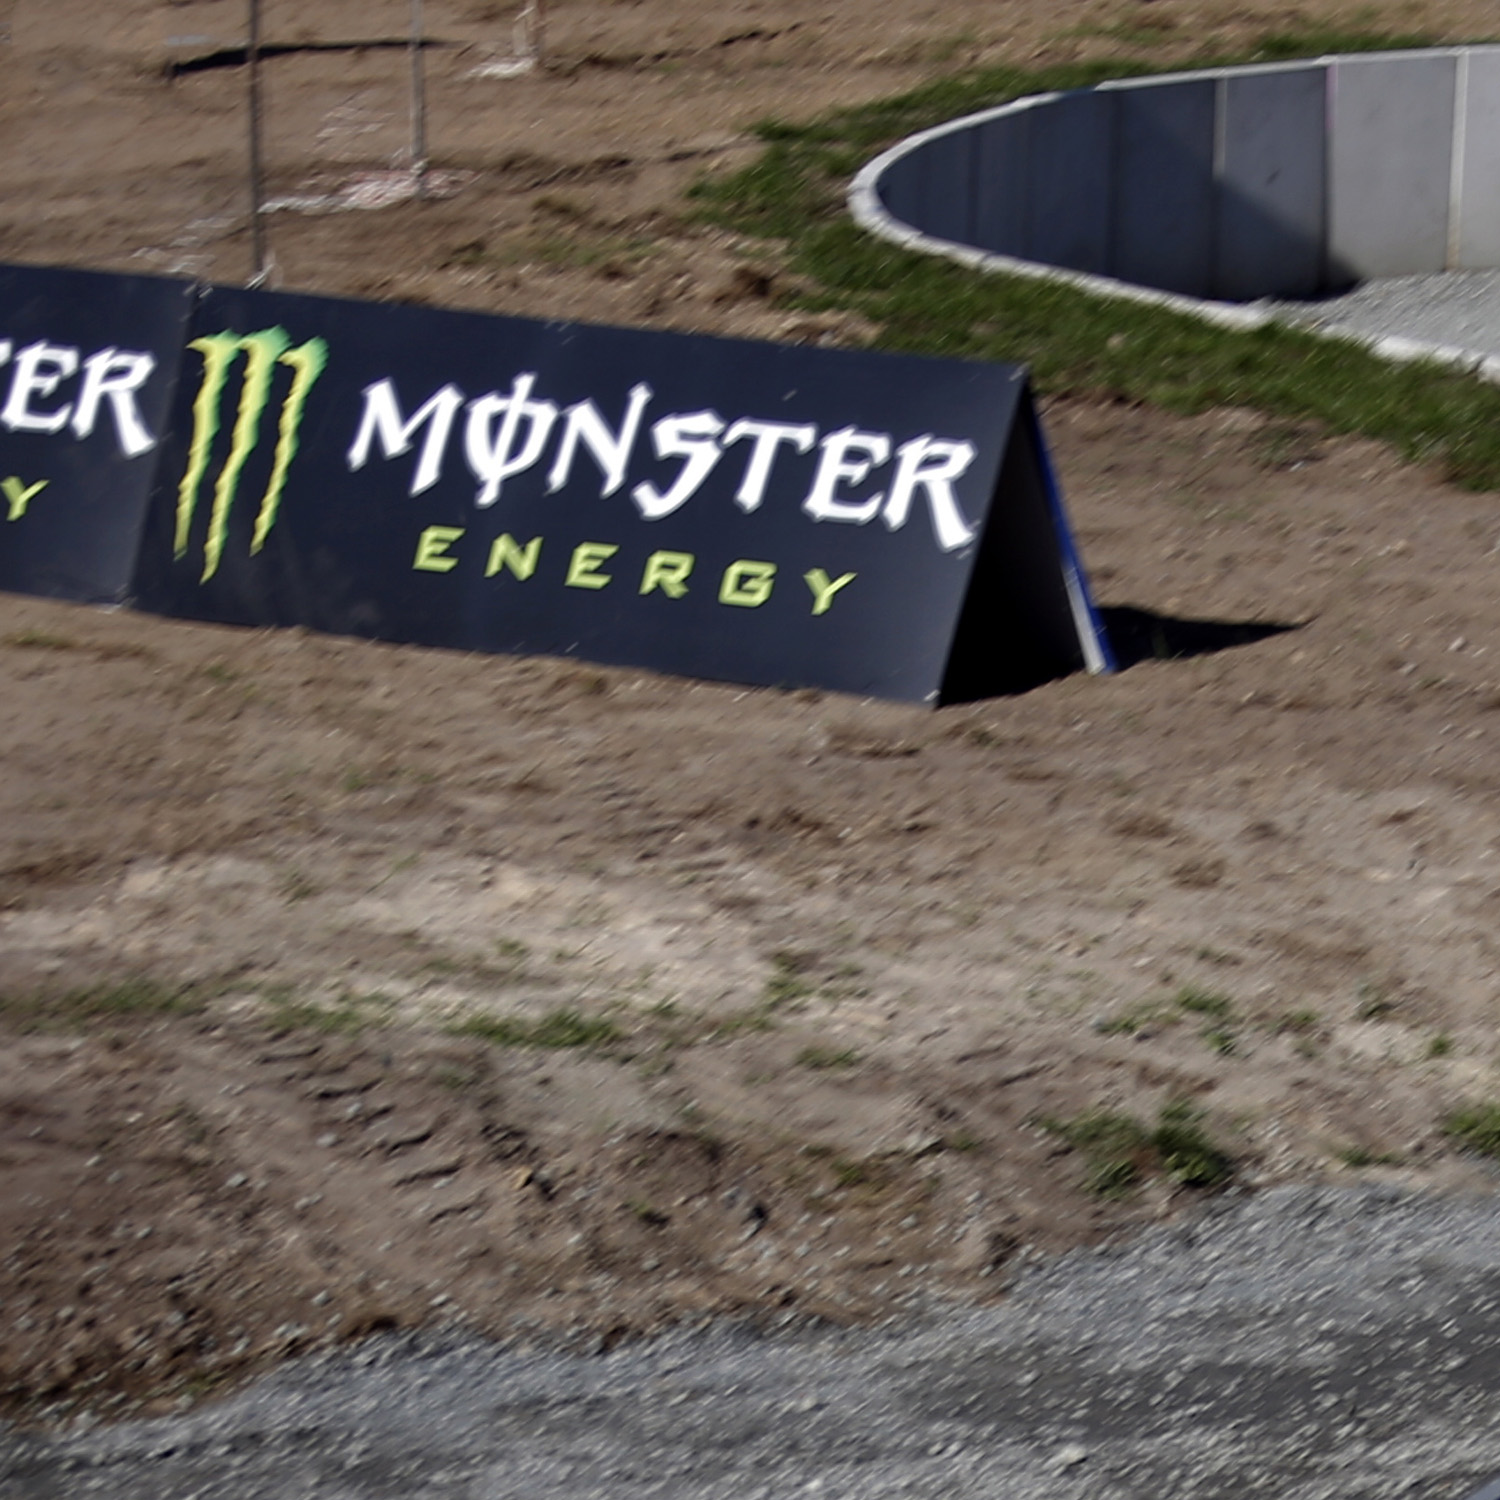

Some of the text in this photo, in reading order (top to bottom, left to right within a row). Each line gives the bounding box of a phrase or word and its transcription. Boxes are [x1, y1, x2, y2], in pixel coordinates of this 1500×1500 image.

[0, 338, 156, 459] ER
[347, 371, 978, 551] MONSTER
[413, 525, 857, 615] ENERGY
